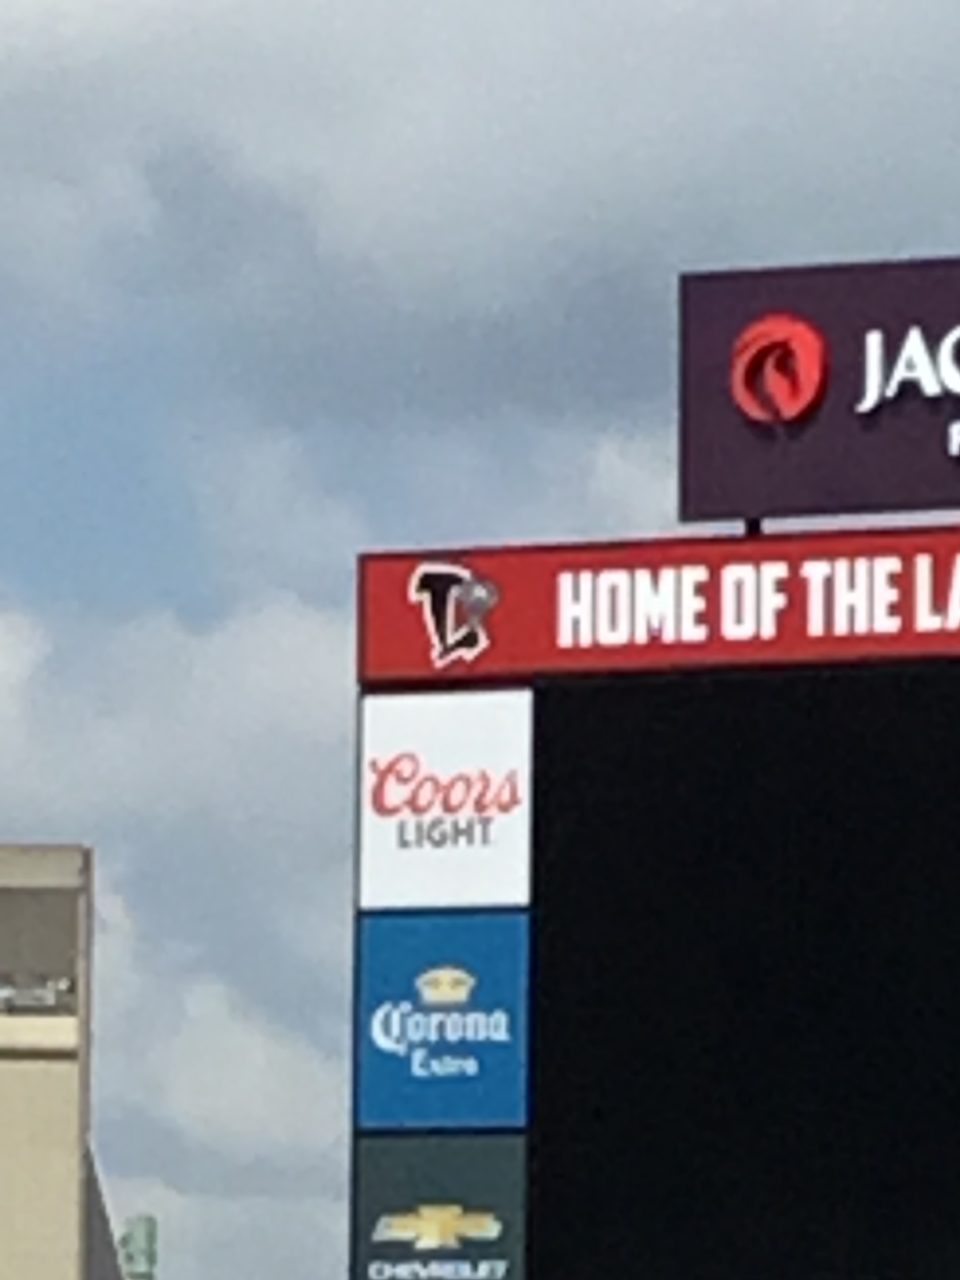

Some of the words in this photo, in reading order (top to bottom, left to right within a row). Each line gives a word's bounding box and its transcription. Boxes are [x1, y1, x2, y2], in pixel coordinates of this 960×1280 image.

[555, 571, 709, 648] HOME
[719, 561, 788, 640] OF
[800, 555, 901, 637] THE
[369, 752, 522, 819] Coors
[397, 816, 494, 850] LIGHT
[371, 1000, 511, 1056] Corona
